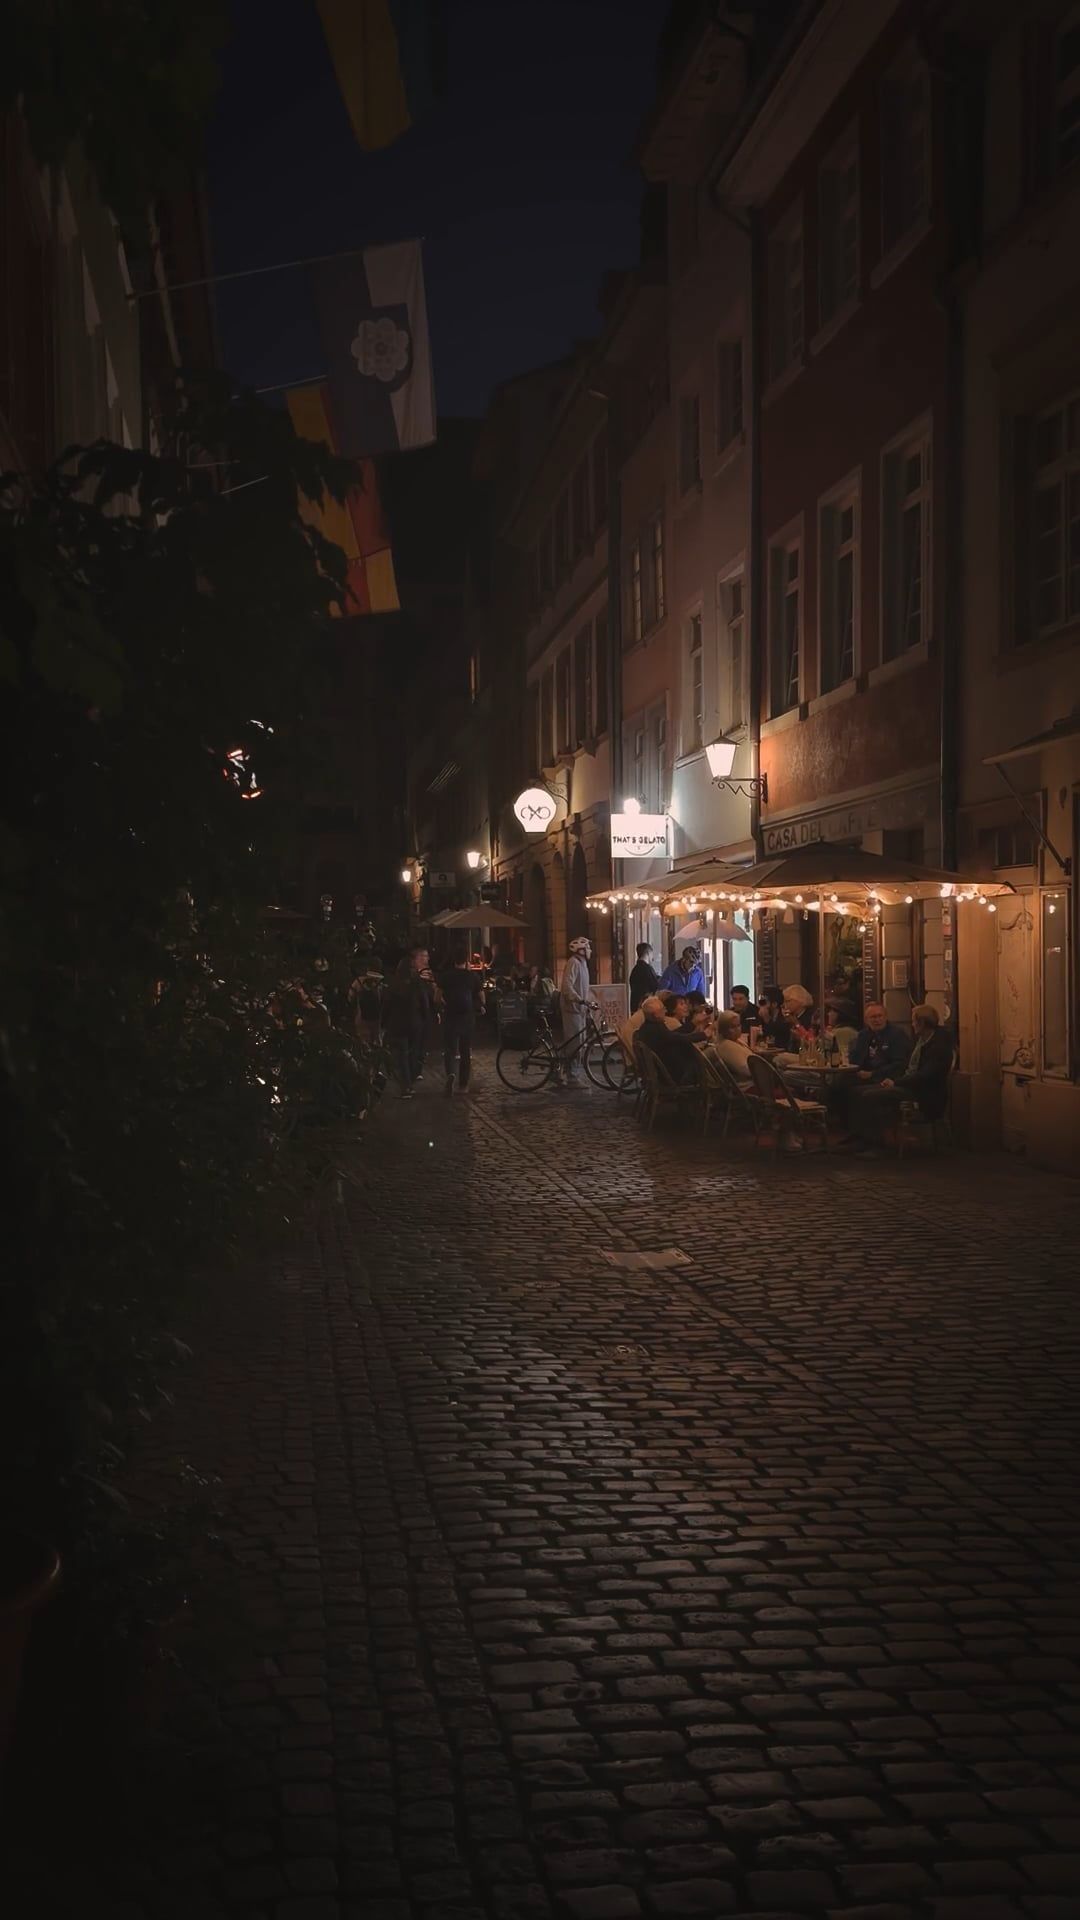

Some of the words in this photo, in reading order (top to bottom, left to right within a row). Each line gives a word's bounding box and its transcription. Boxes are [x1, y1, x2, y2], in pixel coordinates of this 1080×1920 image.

[612, 836, 637, 844] THATS
[638, 836, 666, 844] GELATO
[768, 826, 798, 851] CASA
